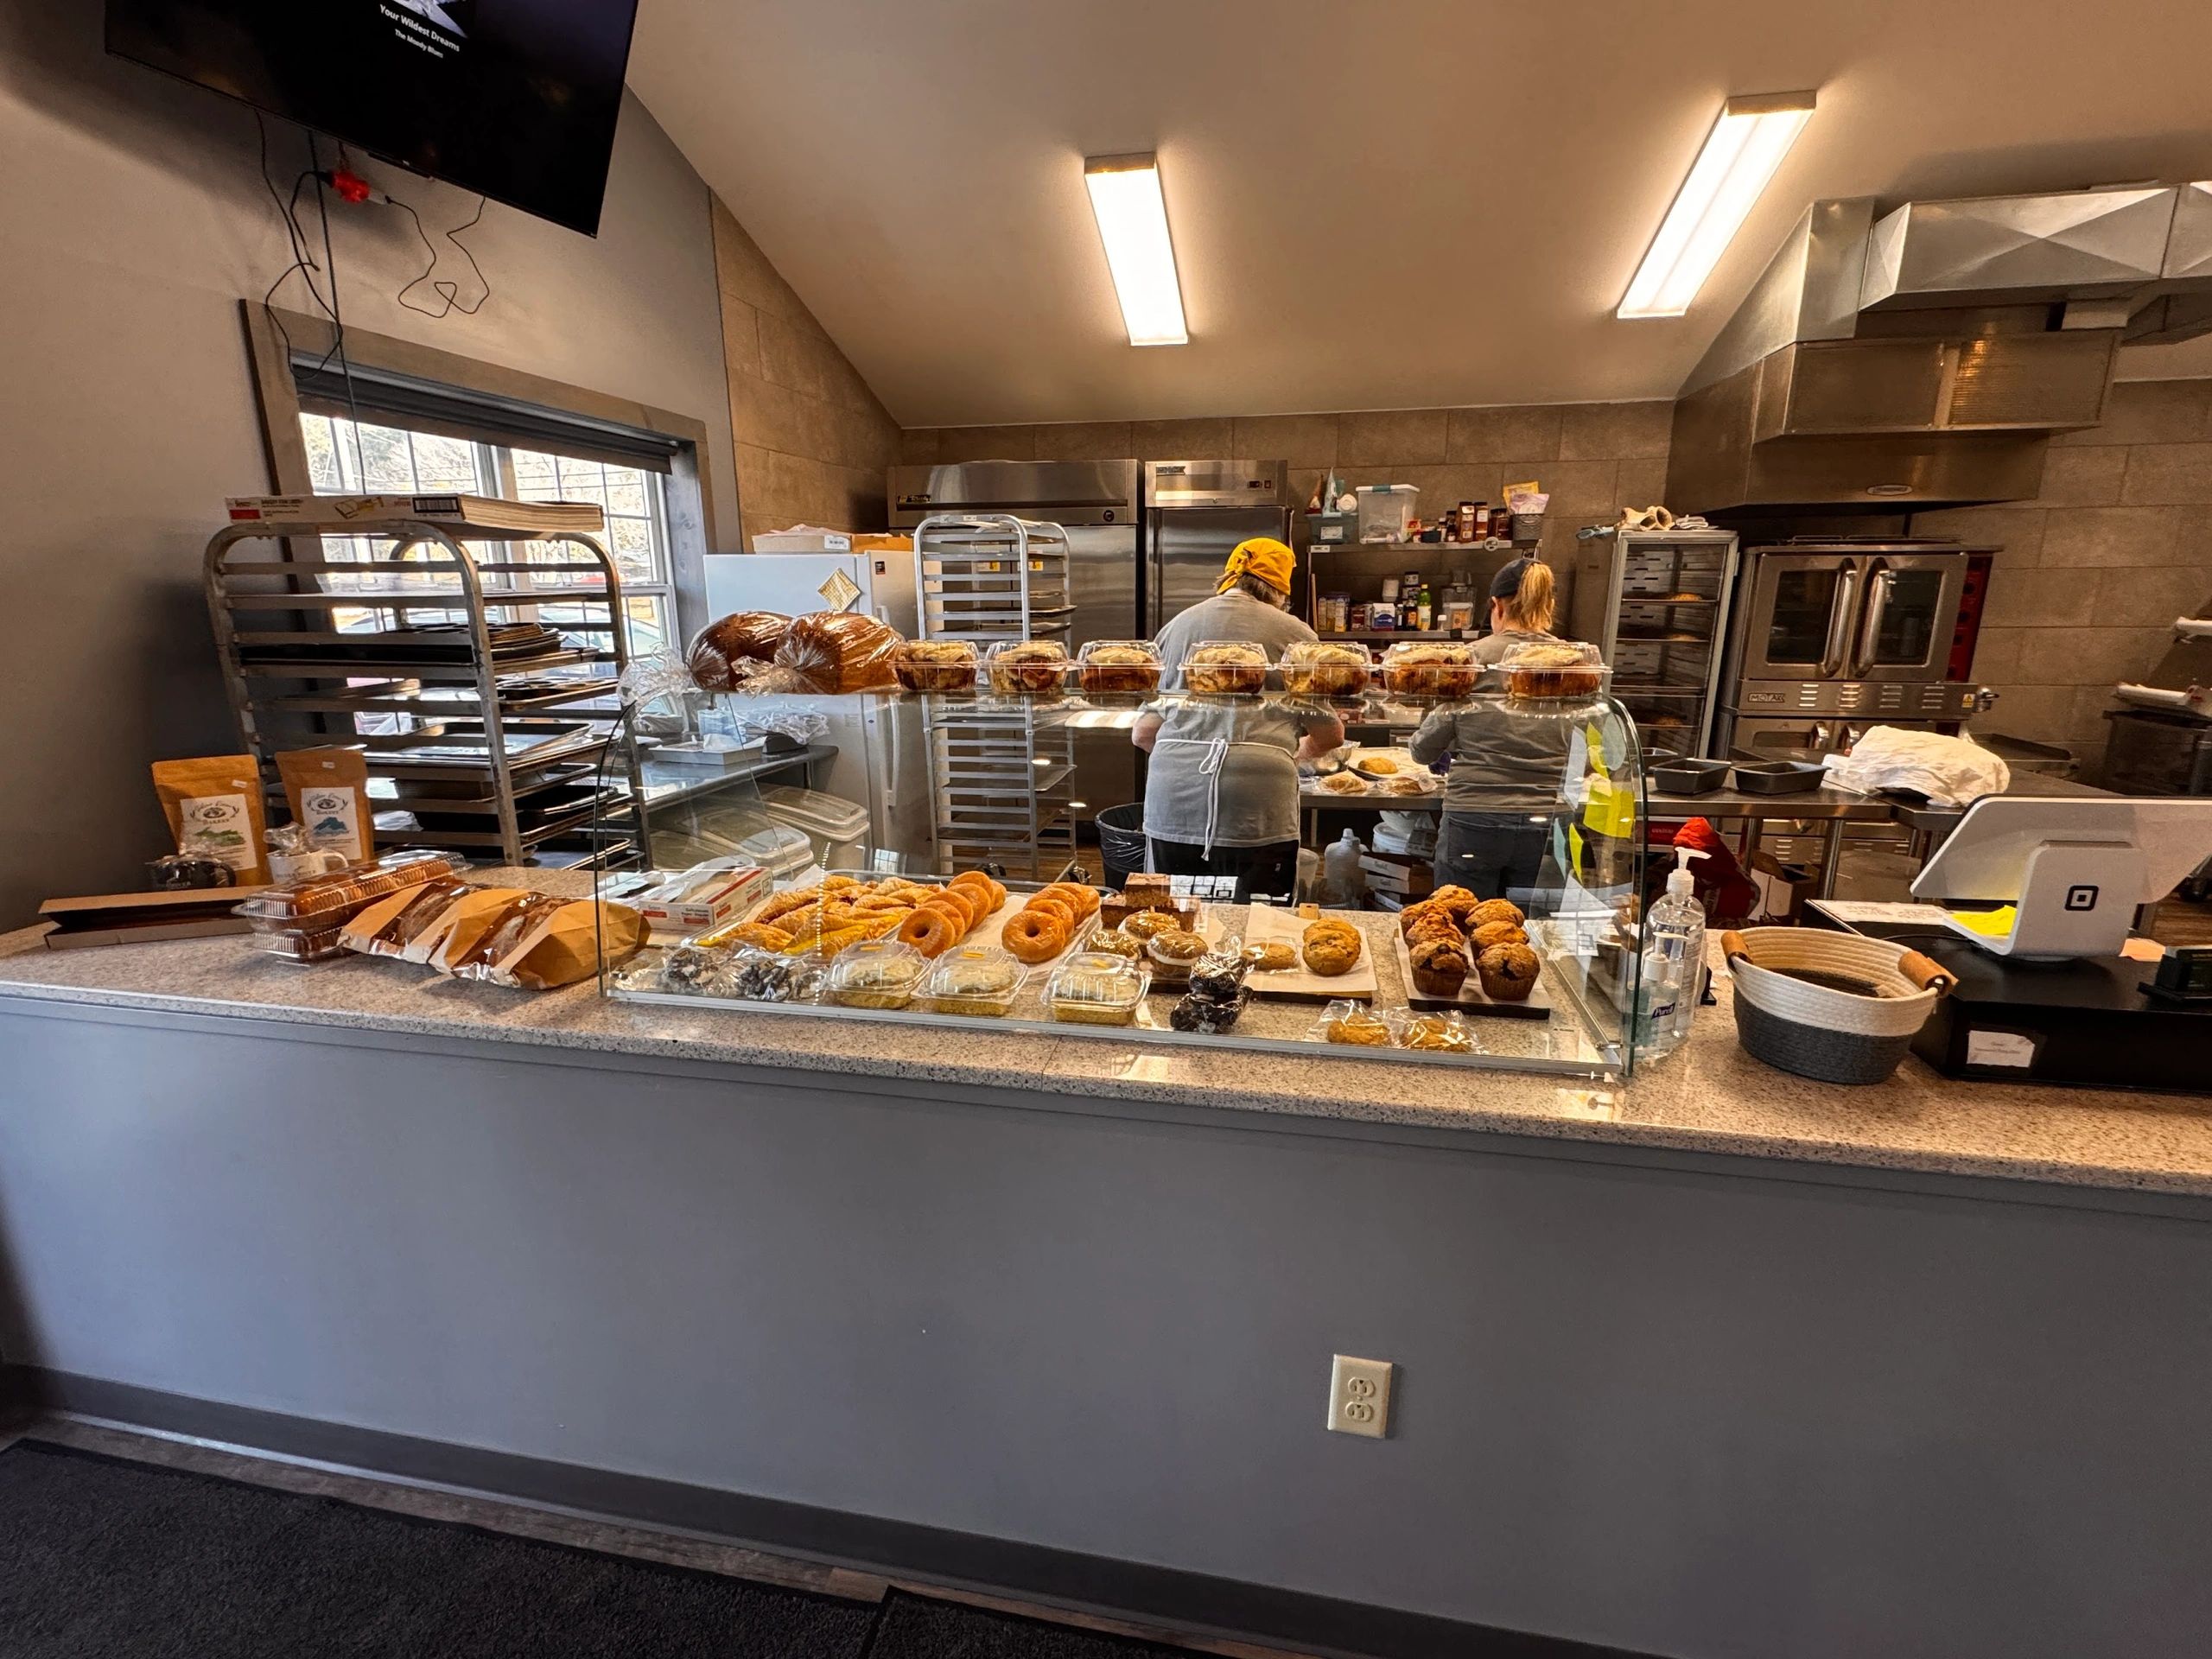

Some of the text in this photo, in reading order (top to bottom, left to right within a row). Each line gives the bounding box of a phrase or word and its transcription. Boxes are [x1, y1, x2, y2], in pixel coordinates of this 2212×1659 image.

[380, 3, 460, 52] Your Wildest Dreams
[395, 29, 406, 40] The
